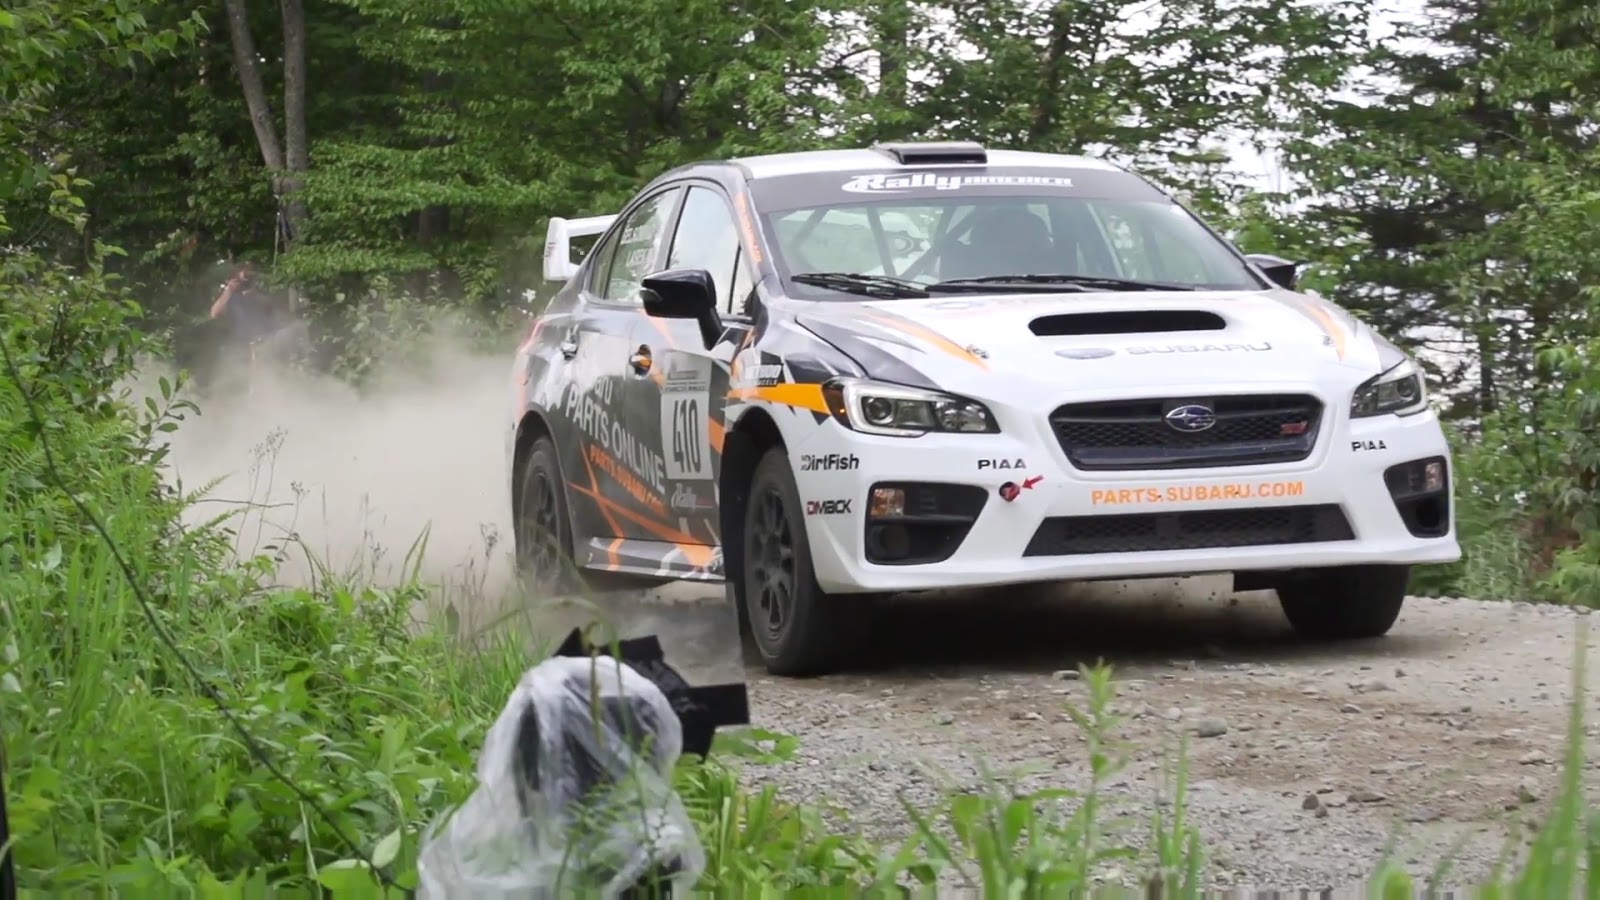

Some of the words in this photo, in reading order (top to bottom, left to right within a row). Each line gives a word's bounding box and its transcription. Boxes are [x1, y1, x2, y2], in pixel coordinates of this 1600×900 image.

[842, 174, 960, 193] Rally
[1126, 342, 1272, 355] SUBARU
[565, 383, 609, 449] PARTS
[612, 421, 666, 495] ONLINE
[673, 399, 701, 474] 410
[1351, 440, 1388, 451] PIAA
[801, 453, 859, 471] DirtFish
[977, 458, 1027, 470] PIAA
[1091, 480, 1303, 505] PARTS.SUBARU.COM
